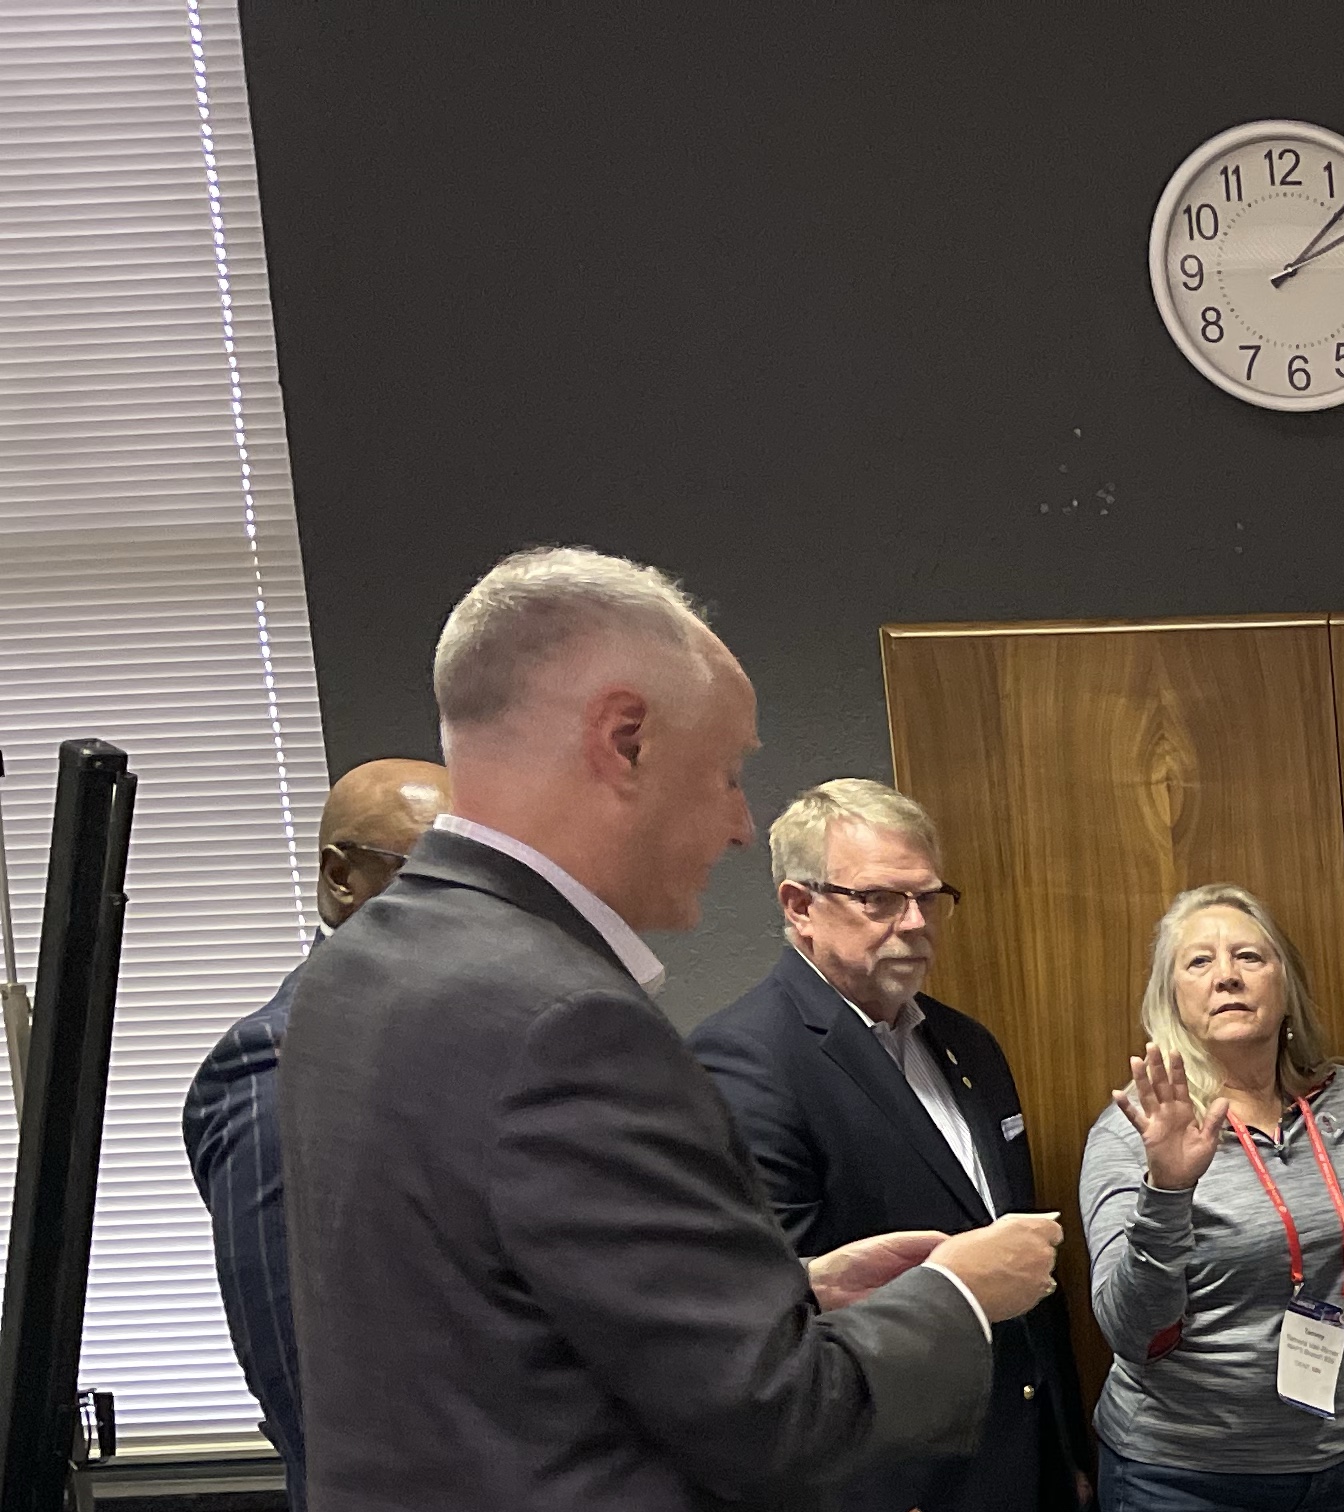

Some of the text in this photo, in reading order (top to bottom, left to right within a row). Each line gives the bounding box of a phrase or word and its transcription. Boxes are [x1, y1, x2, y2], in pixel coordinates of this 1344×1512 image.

[1220, 165, 1242, 202] 11
[1264, 149, 1302, 186] 12
[1323, 161, 1334, 198] 1
[1183, 203, 1219, 240] 10
[1180, 255, 1204, 291] 9
[1201, 307, 1224, 343] 8
[1239, 345, 1261, 380] 7
[1288, 355, 1311, 391] 6
